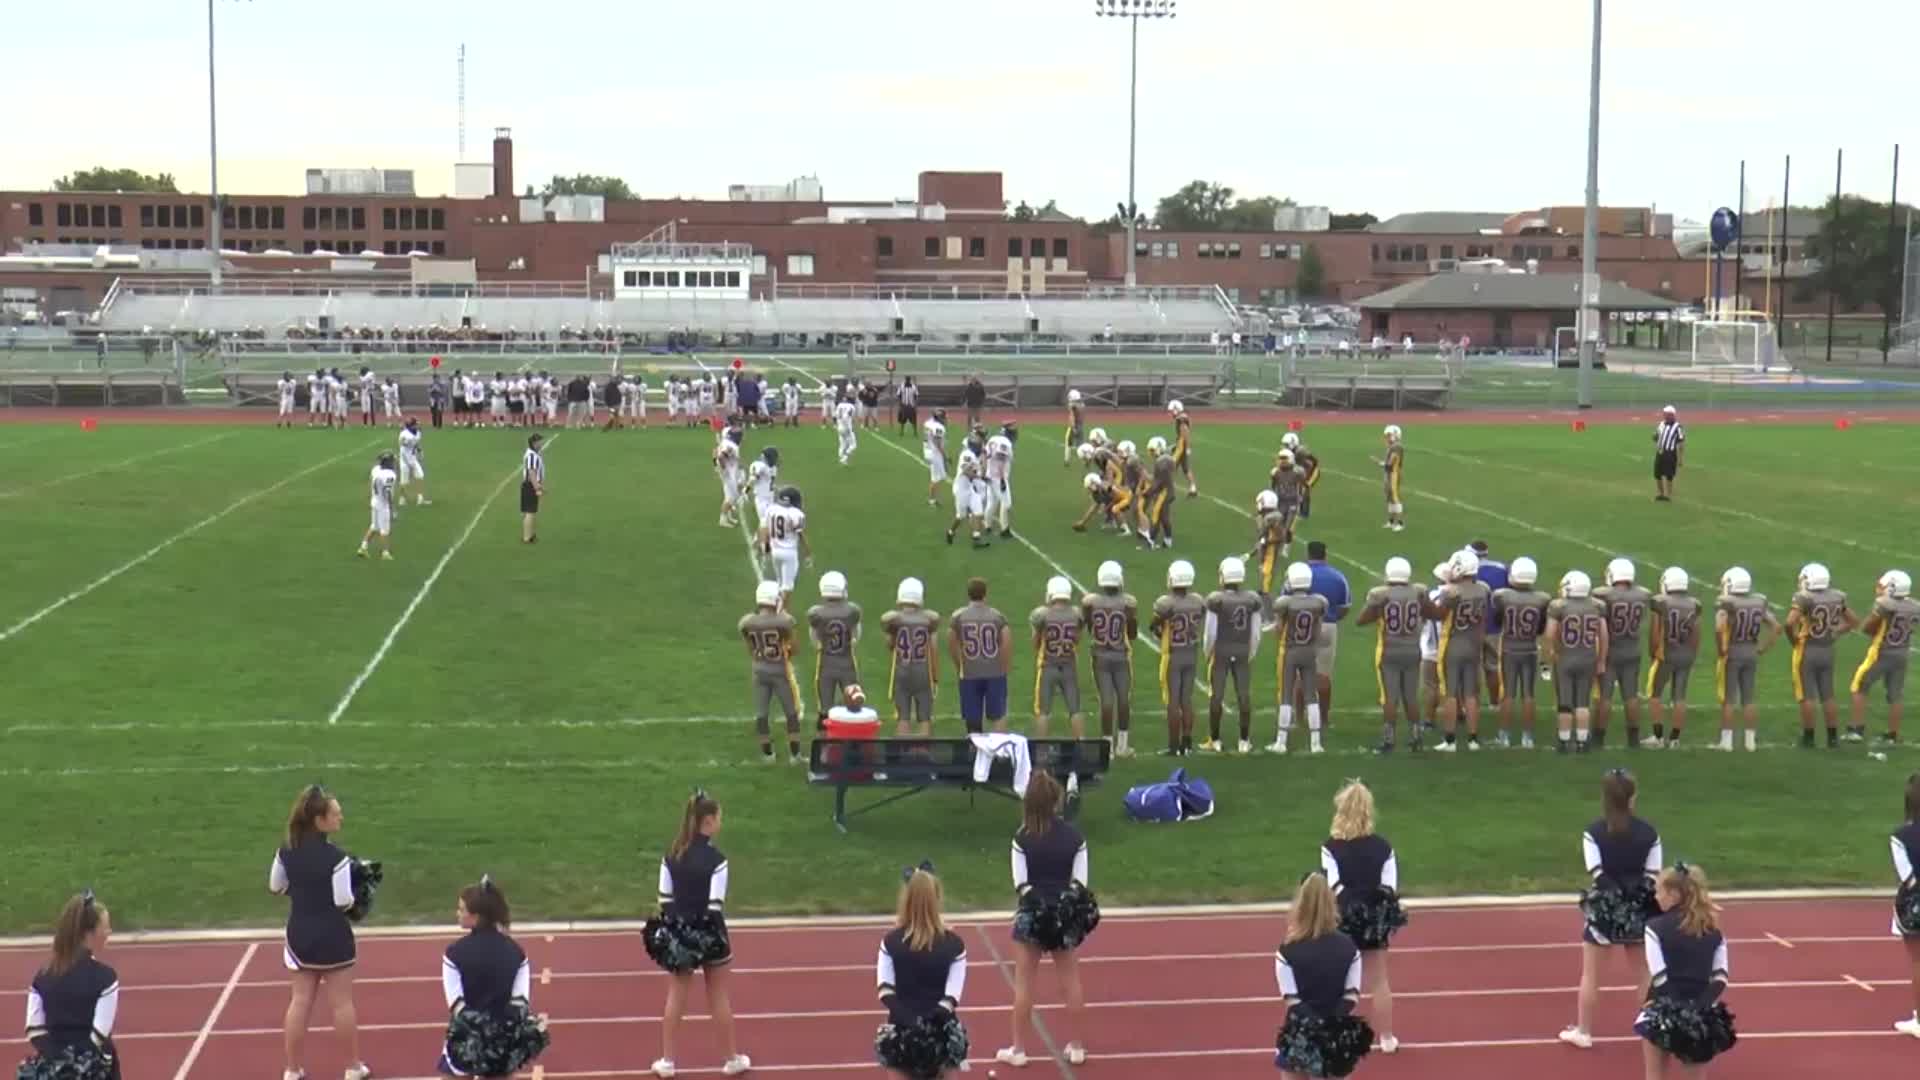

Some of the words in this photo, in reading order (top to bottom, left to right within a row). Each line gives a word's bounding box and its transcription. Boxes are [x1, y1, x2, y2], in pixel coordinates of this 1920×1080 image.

[771, 515, 785, 540] 19
[1092, 611, 1126, 646] 20
[1297, 611, 1312, 645] 9
[1385, 602, 1421, 634] 88
[1562, 614, 1600, 648] 65
[827, 619, 846, 655] 3
[896, 626, 928, 665] 42
[962, 623, 998, 660] 50
